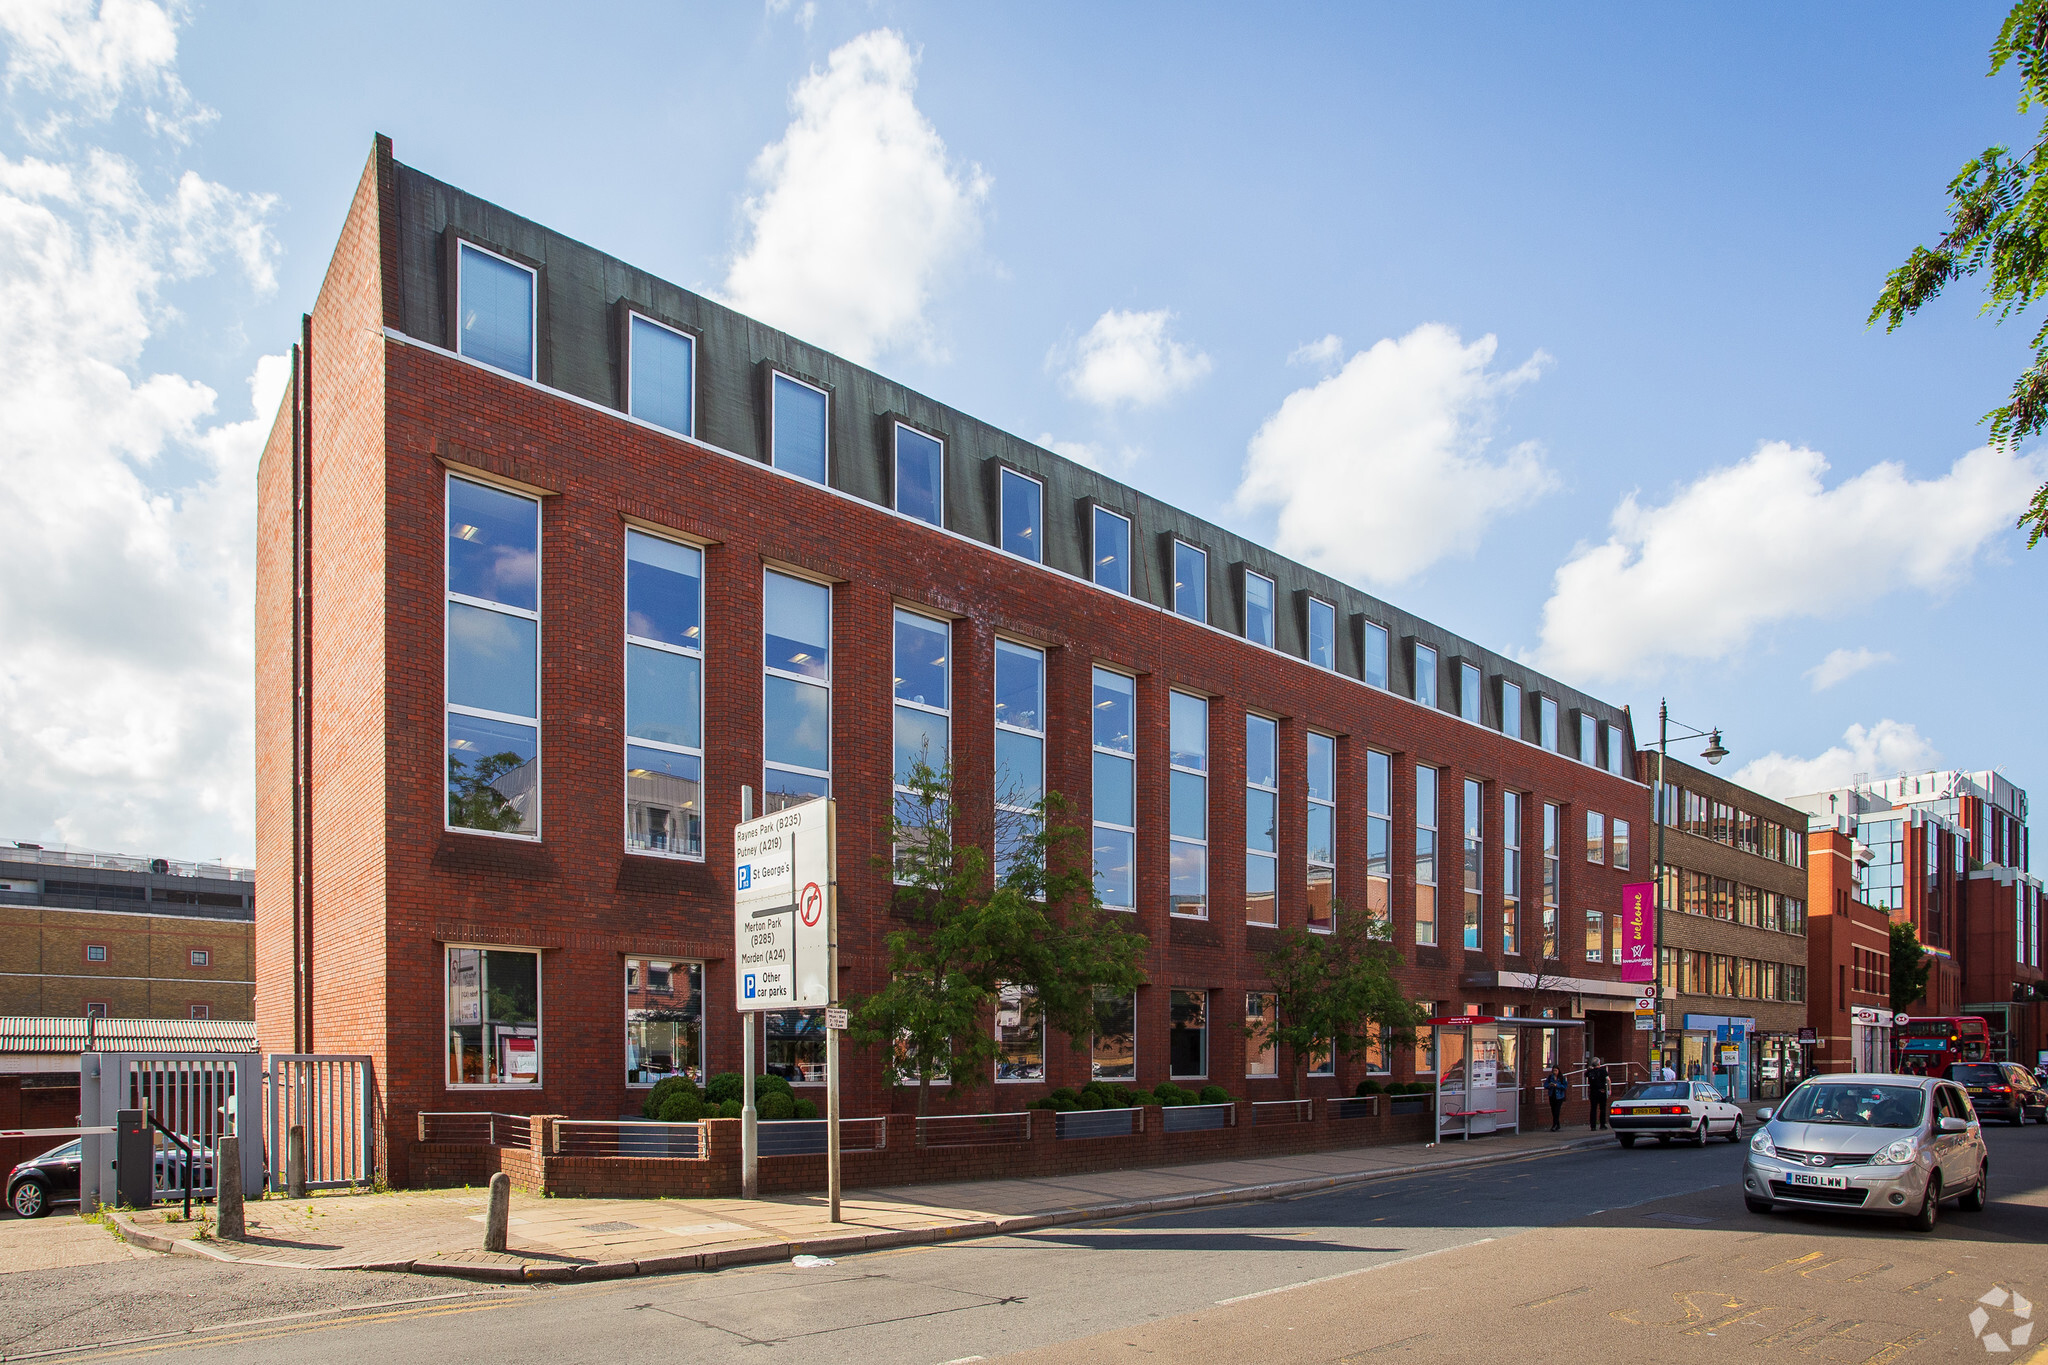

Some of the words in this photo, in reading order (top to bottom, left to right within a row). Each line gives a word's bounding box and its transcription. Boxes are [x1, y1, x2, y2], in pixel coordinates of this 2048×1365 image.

[737, 828, 758, 842] Raynes
[760, 821, 774, 835] Park
[776, 812, 802, 833] (B235)
[737, 845, 758, 859] Putney
[759, 836, 783, 855] (A219)
[752, 868, 761, 880] St
[762, 862, 790, 878] George's
[1630, 892, 1643, 940] welcome
[744, 921, 766, 933] Merton
[767, 917, 782, 930] Park
[750, 932, 775, 948] (B285)
[741, 952, 764, 964] Morden
[765, 948, 786, 964] (A24)
[762, 971, 781, 983] Other
[746, 976, 755, 997] P
[757, 988, 768, 997] car
[768, 985, 787, 998] parks
[1795, 1174, 1818, 1185] RE10
[1820, 1176, 1842, 1187] LWW
